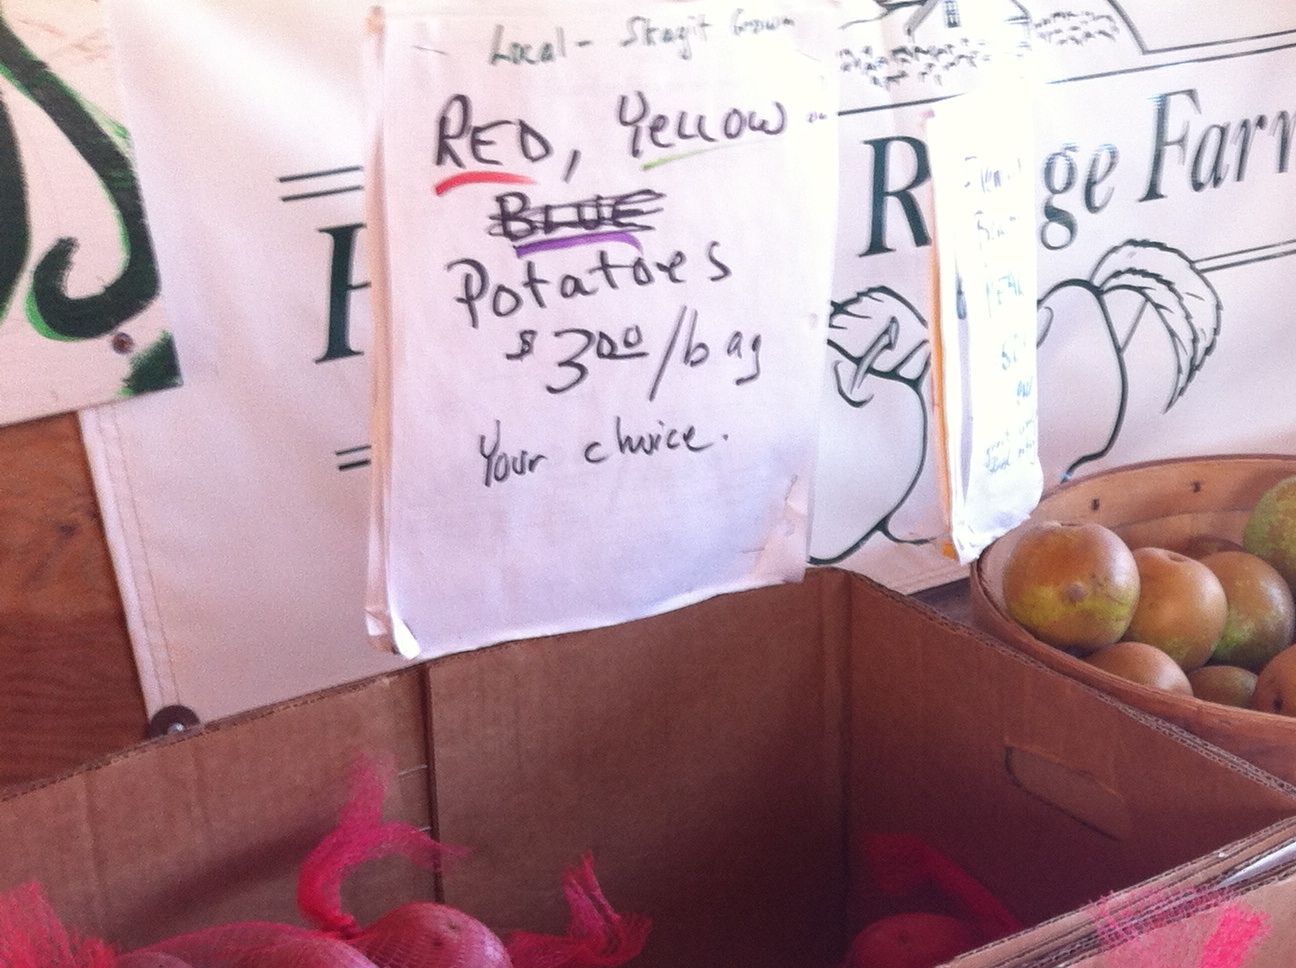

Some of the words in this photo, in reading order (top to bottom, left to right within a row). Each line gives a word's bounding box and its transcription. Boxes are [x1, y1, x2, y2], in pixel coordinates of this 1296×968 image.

[618, 90, 787, 158] Yellow
[447, 241, 731, 328] Potatoes
[480, 420, 548, 487] Your
